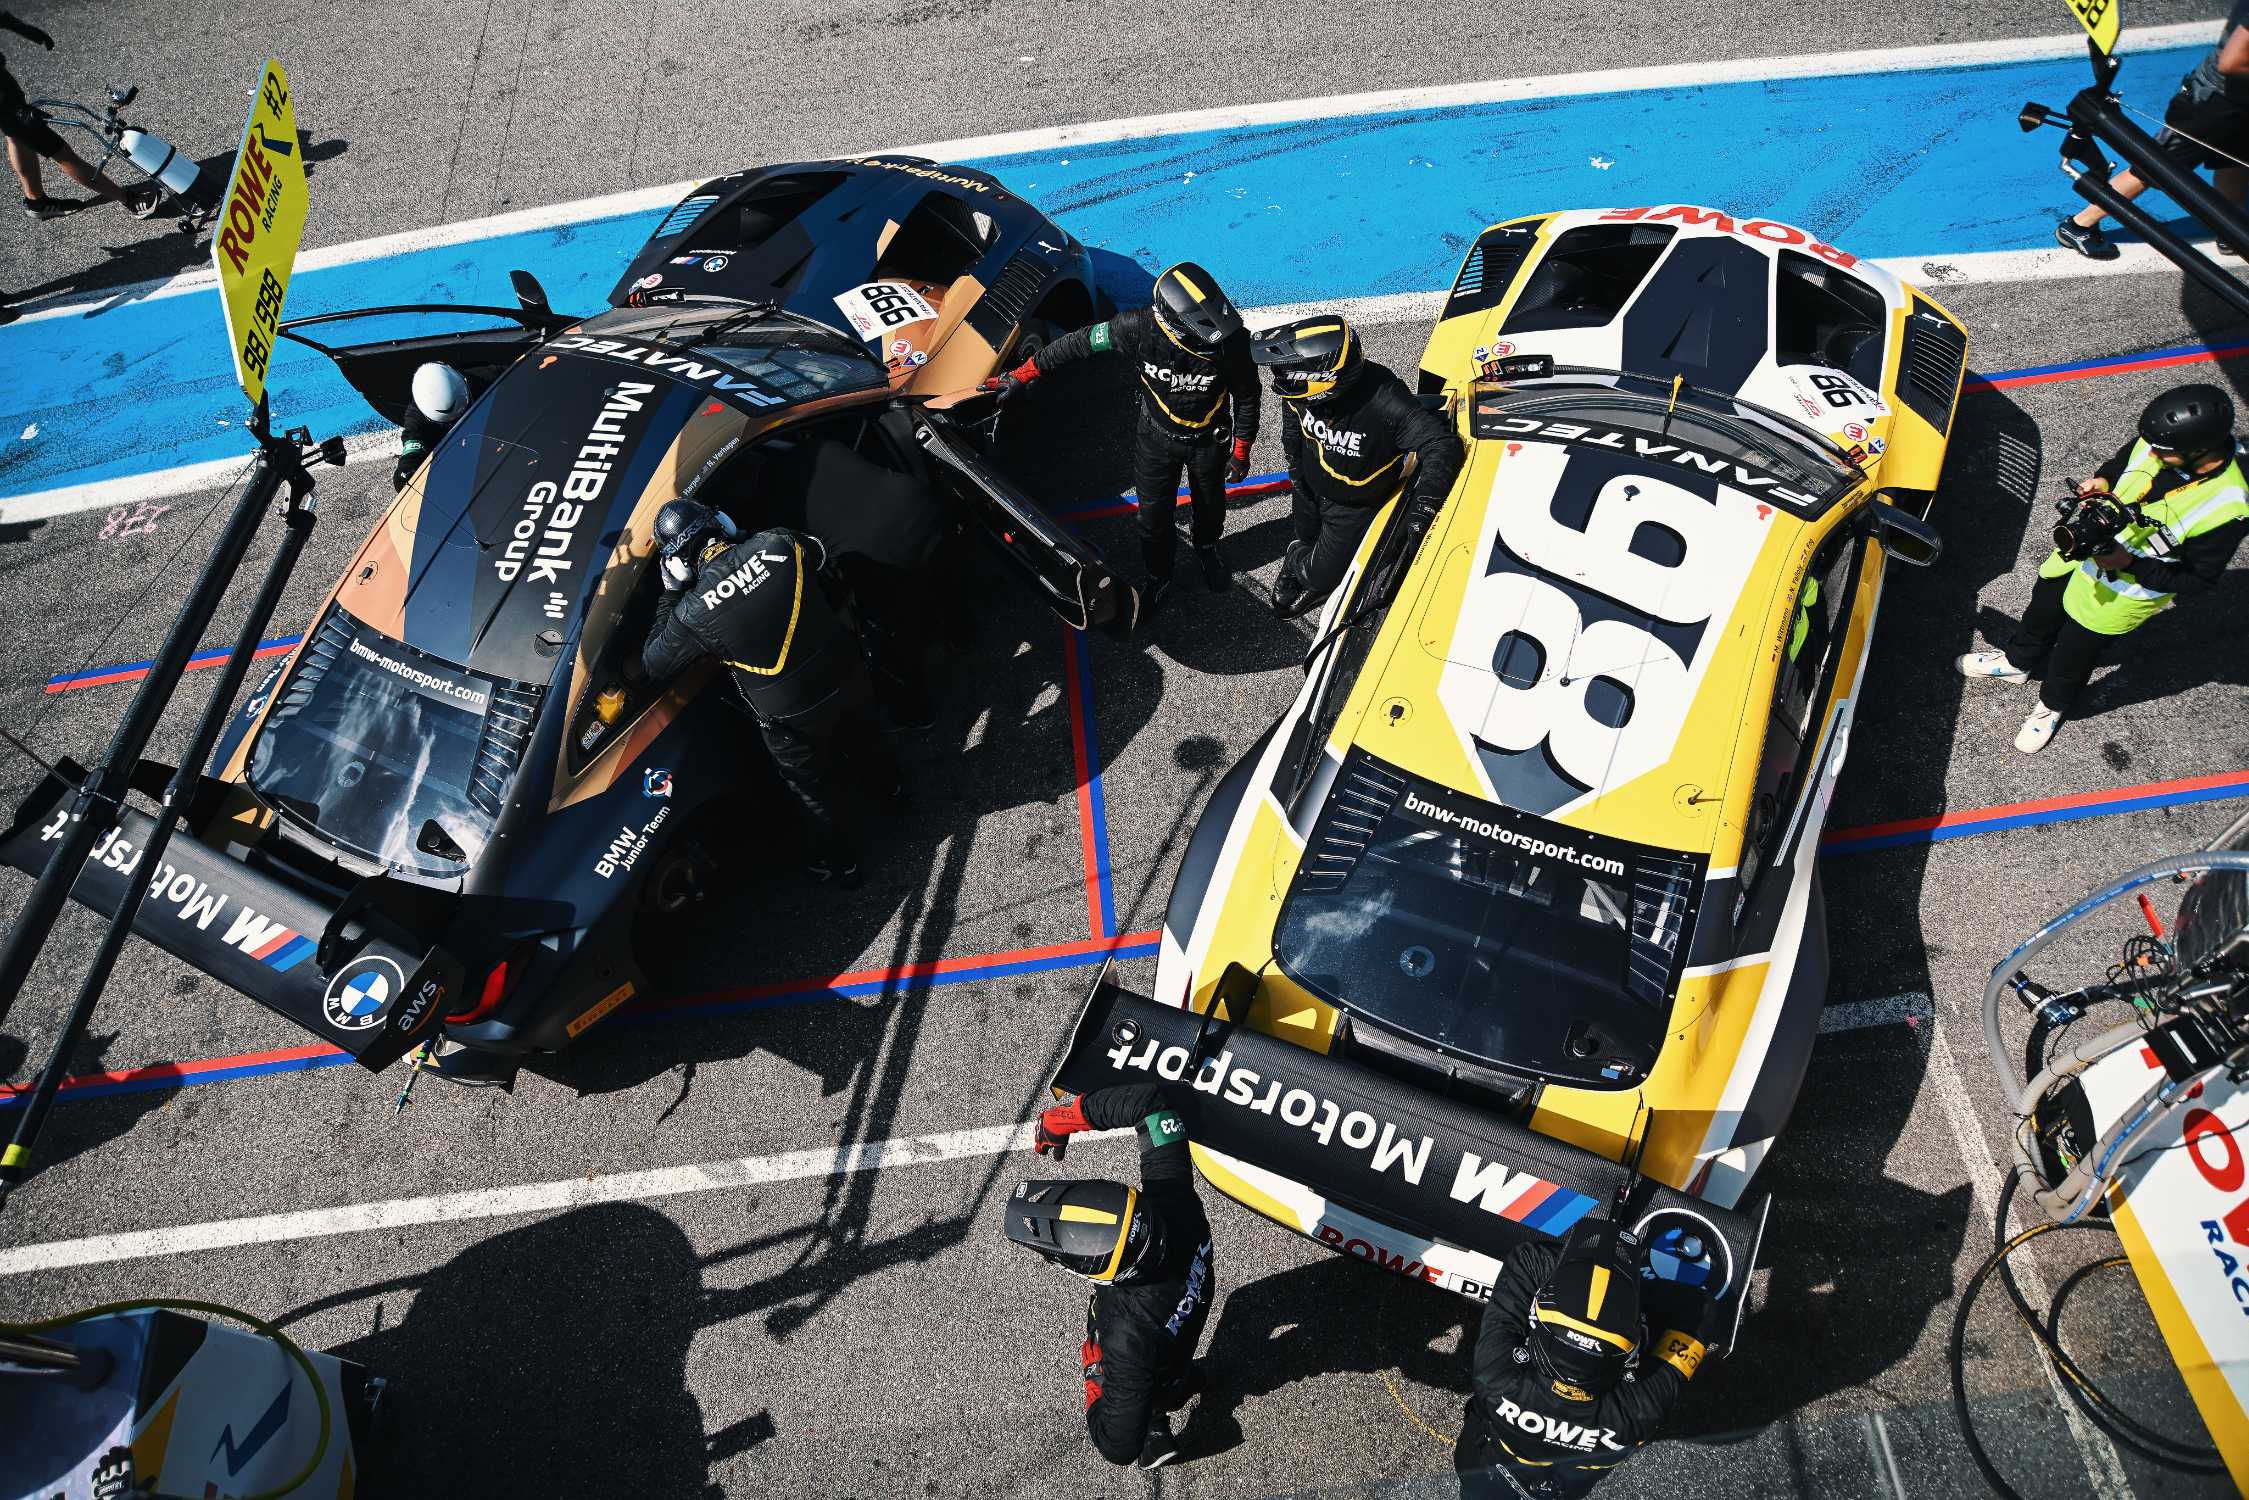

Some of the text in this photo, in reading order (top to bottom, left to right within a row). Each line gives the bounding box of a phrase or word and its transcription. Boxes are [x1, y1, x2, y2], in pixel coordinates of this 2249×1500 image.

[263, 72, 288, 122] #2
[219, 134, 273, 277] ROWE
[261, 174, 283, 233] RACING
[1598, 206, 1860, 274] ROWE
[860, 284, 920, 327] 998
[544, 337, 787, 407] FANATEC
[1142, 361, 1217, 388] ROWE
[1808, 374, 1867, 408] 98
[1302, 408, 1362, 451] ROWE
[526, 380, 656, 586] MultiBank
[683, 474, 702, 497] Harper
[713, 436, 741, 461] Verhagen
[1493, 418, 1819, 507] FANATEC
[494, 480, 557, 583] Group
[700, 556, 769, 611] ROWE
[742, 569, 771, 596] RACING
[1442, 444, 1728, 806] 98
[1776, 607, 1790, 643] Wittmann
[349, 637, 486, 704] bmw-motorsport.com
[593, 826, 637, 879] BMW
[620, 806, 671, 872] Junior Team
[1403, 792, 1626, 877] bmw-motorsport.com
[328, 997, 373, 1026] BMW
[398, 980, 437, 1031] aws
[1107, 1039, 1436, 1184] Motorsport
[1318, 1223, 1444, 1284] ROWE
[1165, 1256, 1207, 1337] ROWE
[1566, 1330, 1596, 1347] ROWE
[1495, 1396, 1600, 1450] ROWE
[1543, 1437, 1593, 1453] RACING
